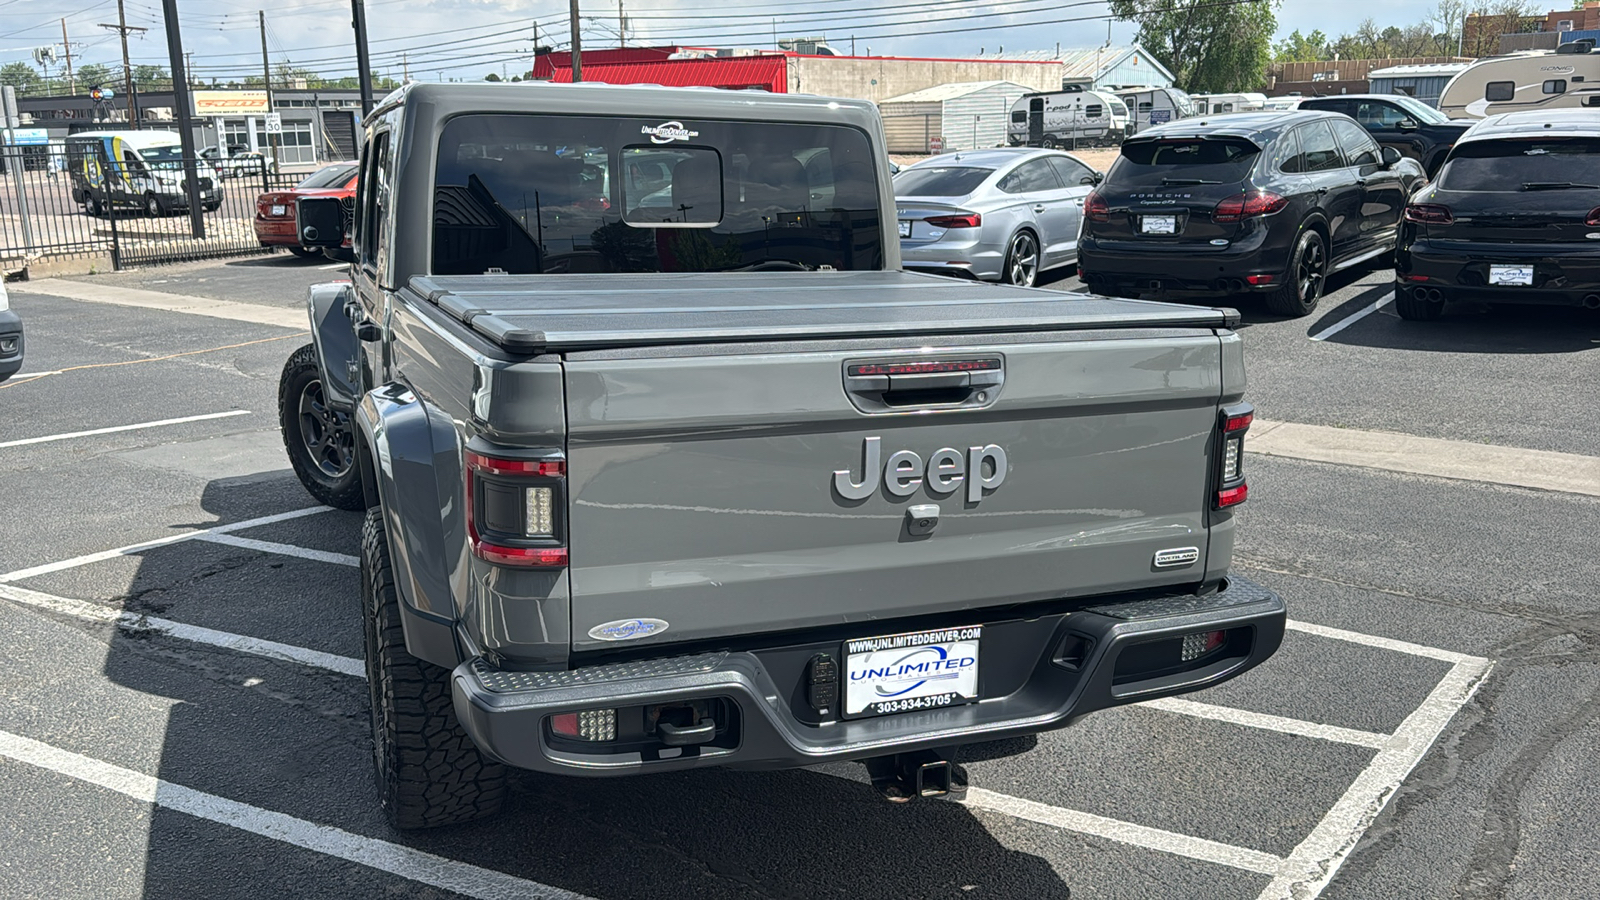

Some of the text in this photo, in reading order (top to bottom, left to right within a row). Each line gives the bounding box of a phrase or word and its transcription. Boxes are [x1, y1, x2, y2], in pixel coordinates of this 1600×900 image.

[267, 123, 280, 131] 30
[858, 362, 989, 374] GLADIATOR
[833, 436, 1007, 502] Jeep
[1157, 553, 1198, 561] OVERLAND
[850, 657, 975, 680] UNLIMITED
[850, 677, 887, 685] AUTO
[898, 670, 941, 679] SALES
[877, 694, 951, 714] 303-934-3705
